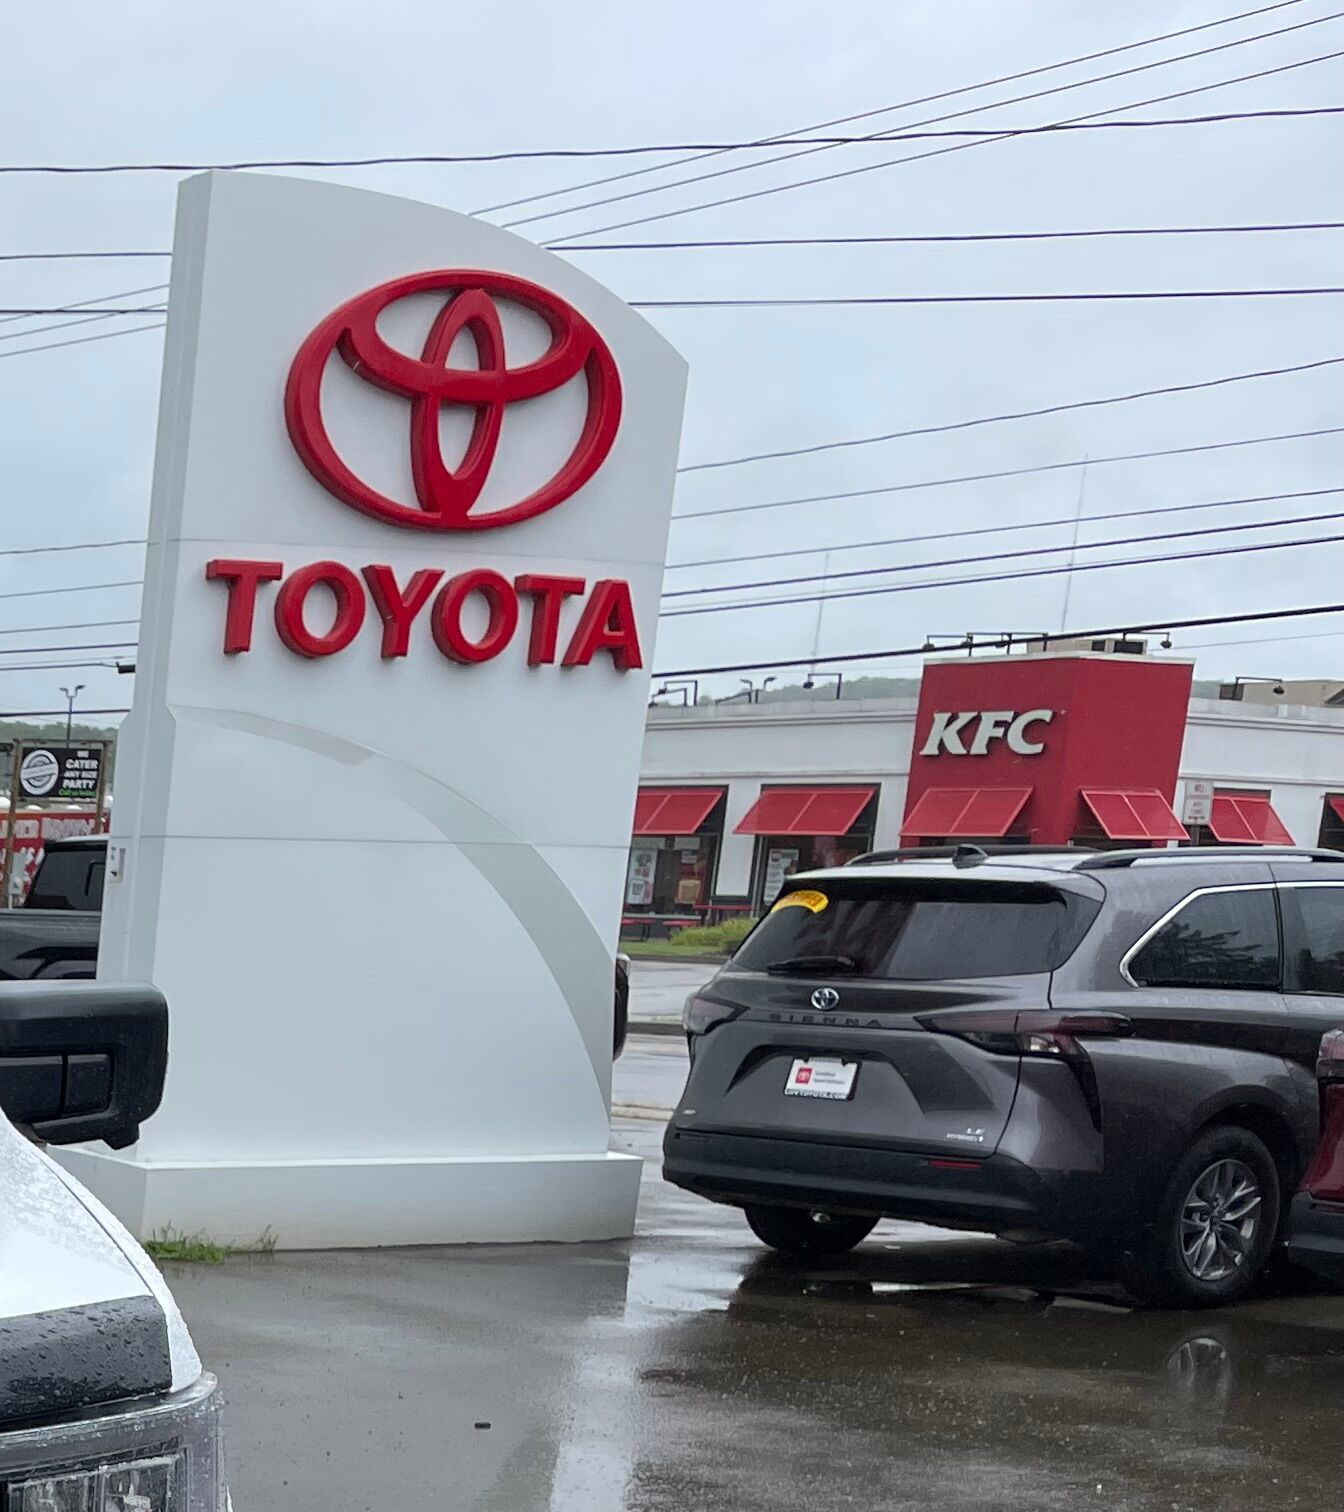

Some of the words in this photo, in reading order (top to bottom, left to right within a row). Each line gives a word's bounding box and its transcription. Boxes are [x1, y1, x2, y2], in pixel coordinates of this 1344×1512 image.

[205, 558, 643, 670] TOYOTA
[919, 709, 1054, 756] KFC
[65, 758, 99, 769] CATER
[63, 779, 96, 789] PARTY
[769, 1013, 883, 1027] SIENNA
